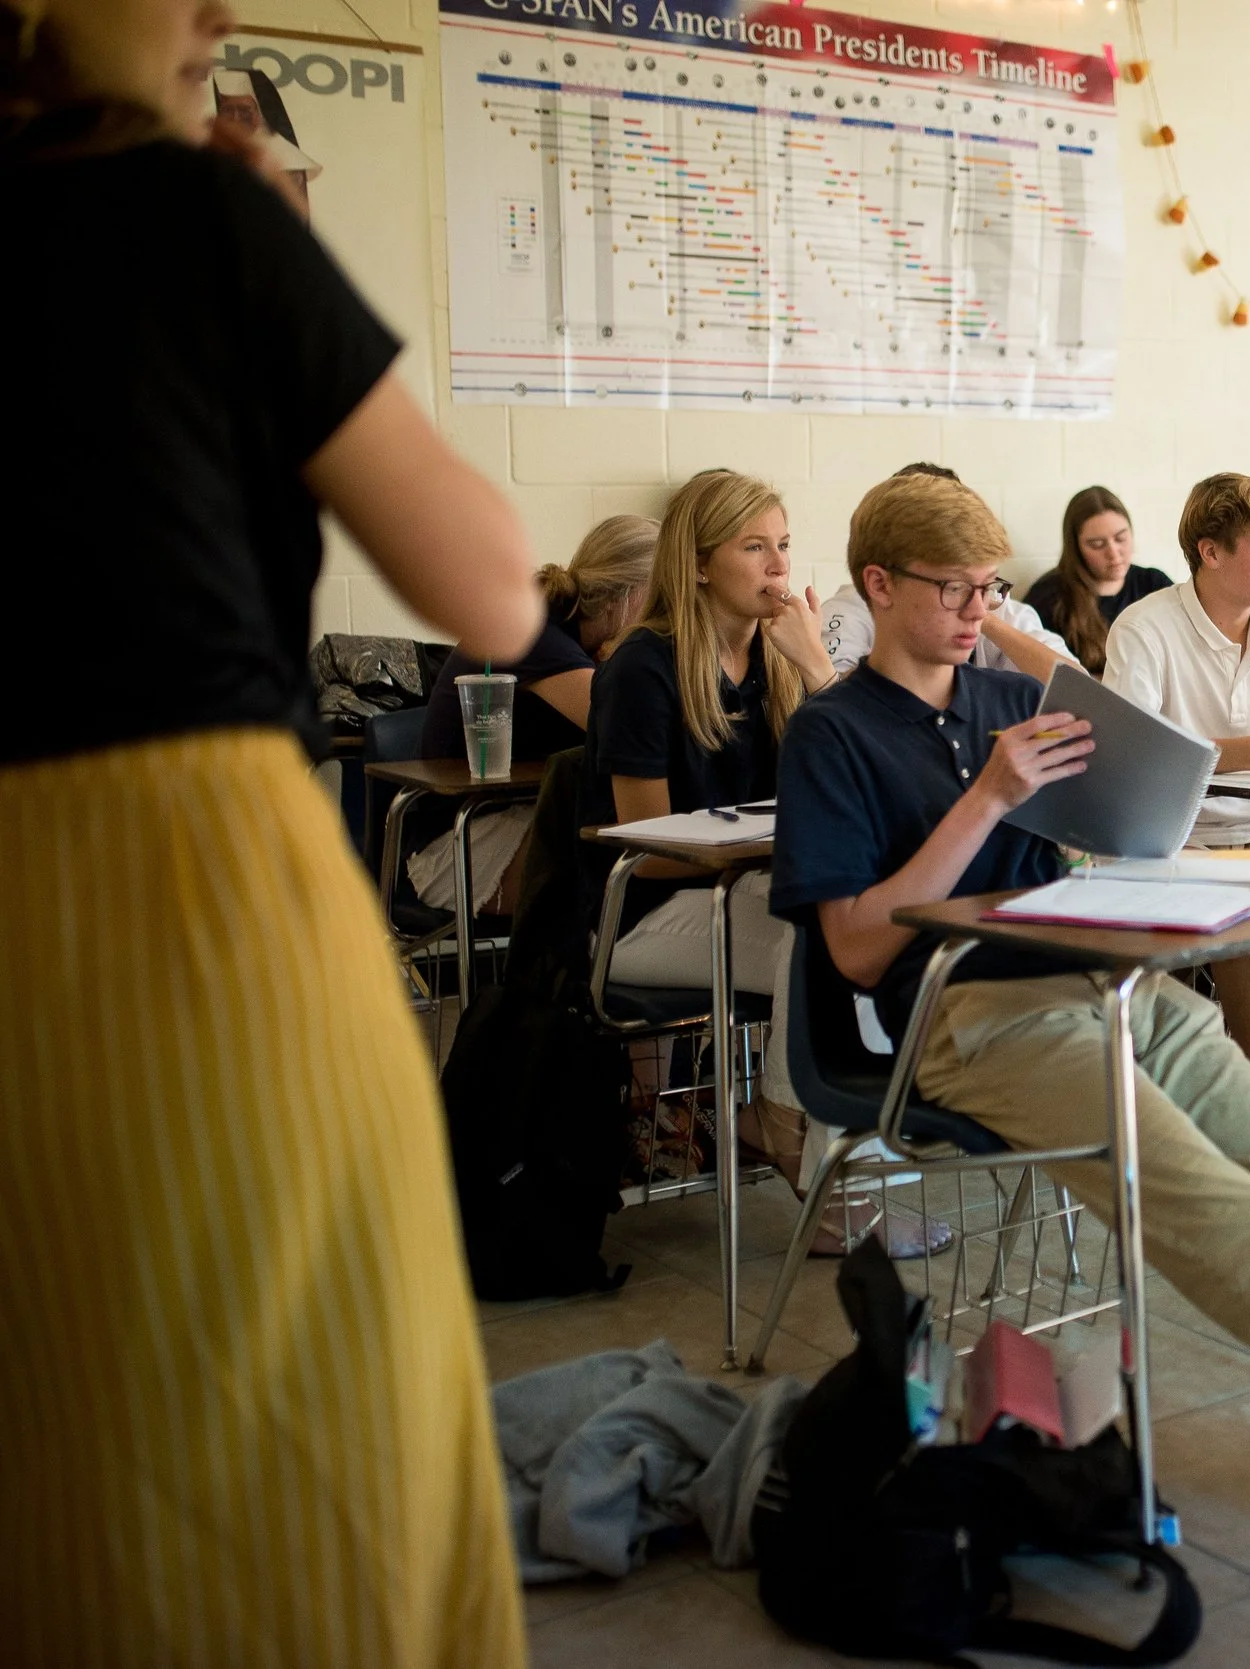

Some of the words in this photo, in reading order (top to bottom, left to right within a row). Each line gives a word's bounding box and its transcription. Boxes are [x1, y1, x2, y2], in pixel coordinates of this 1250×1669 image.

[484, 0, 638, 27] PAN's
[649, 0, 803, 50] American
[812, 22, 964, 75] Presidents
[971, 48, 1088, 94] Timeline
